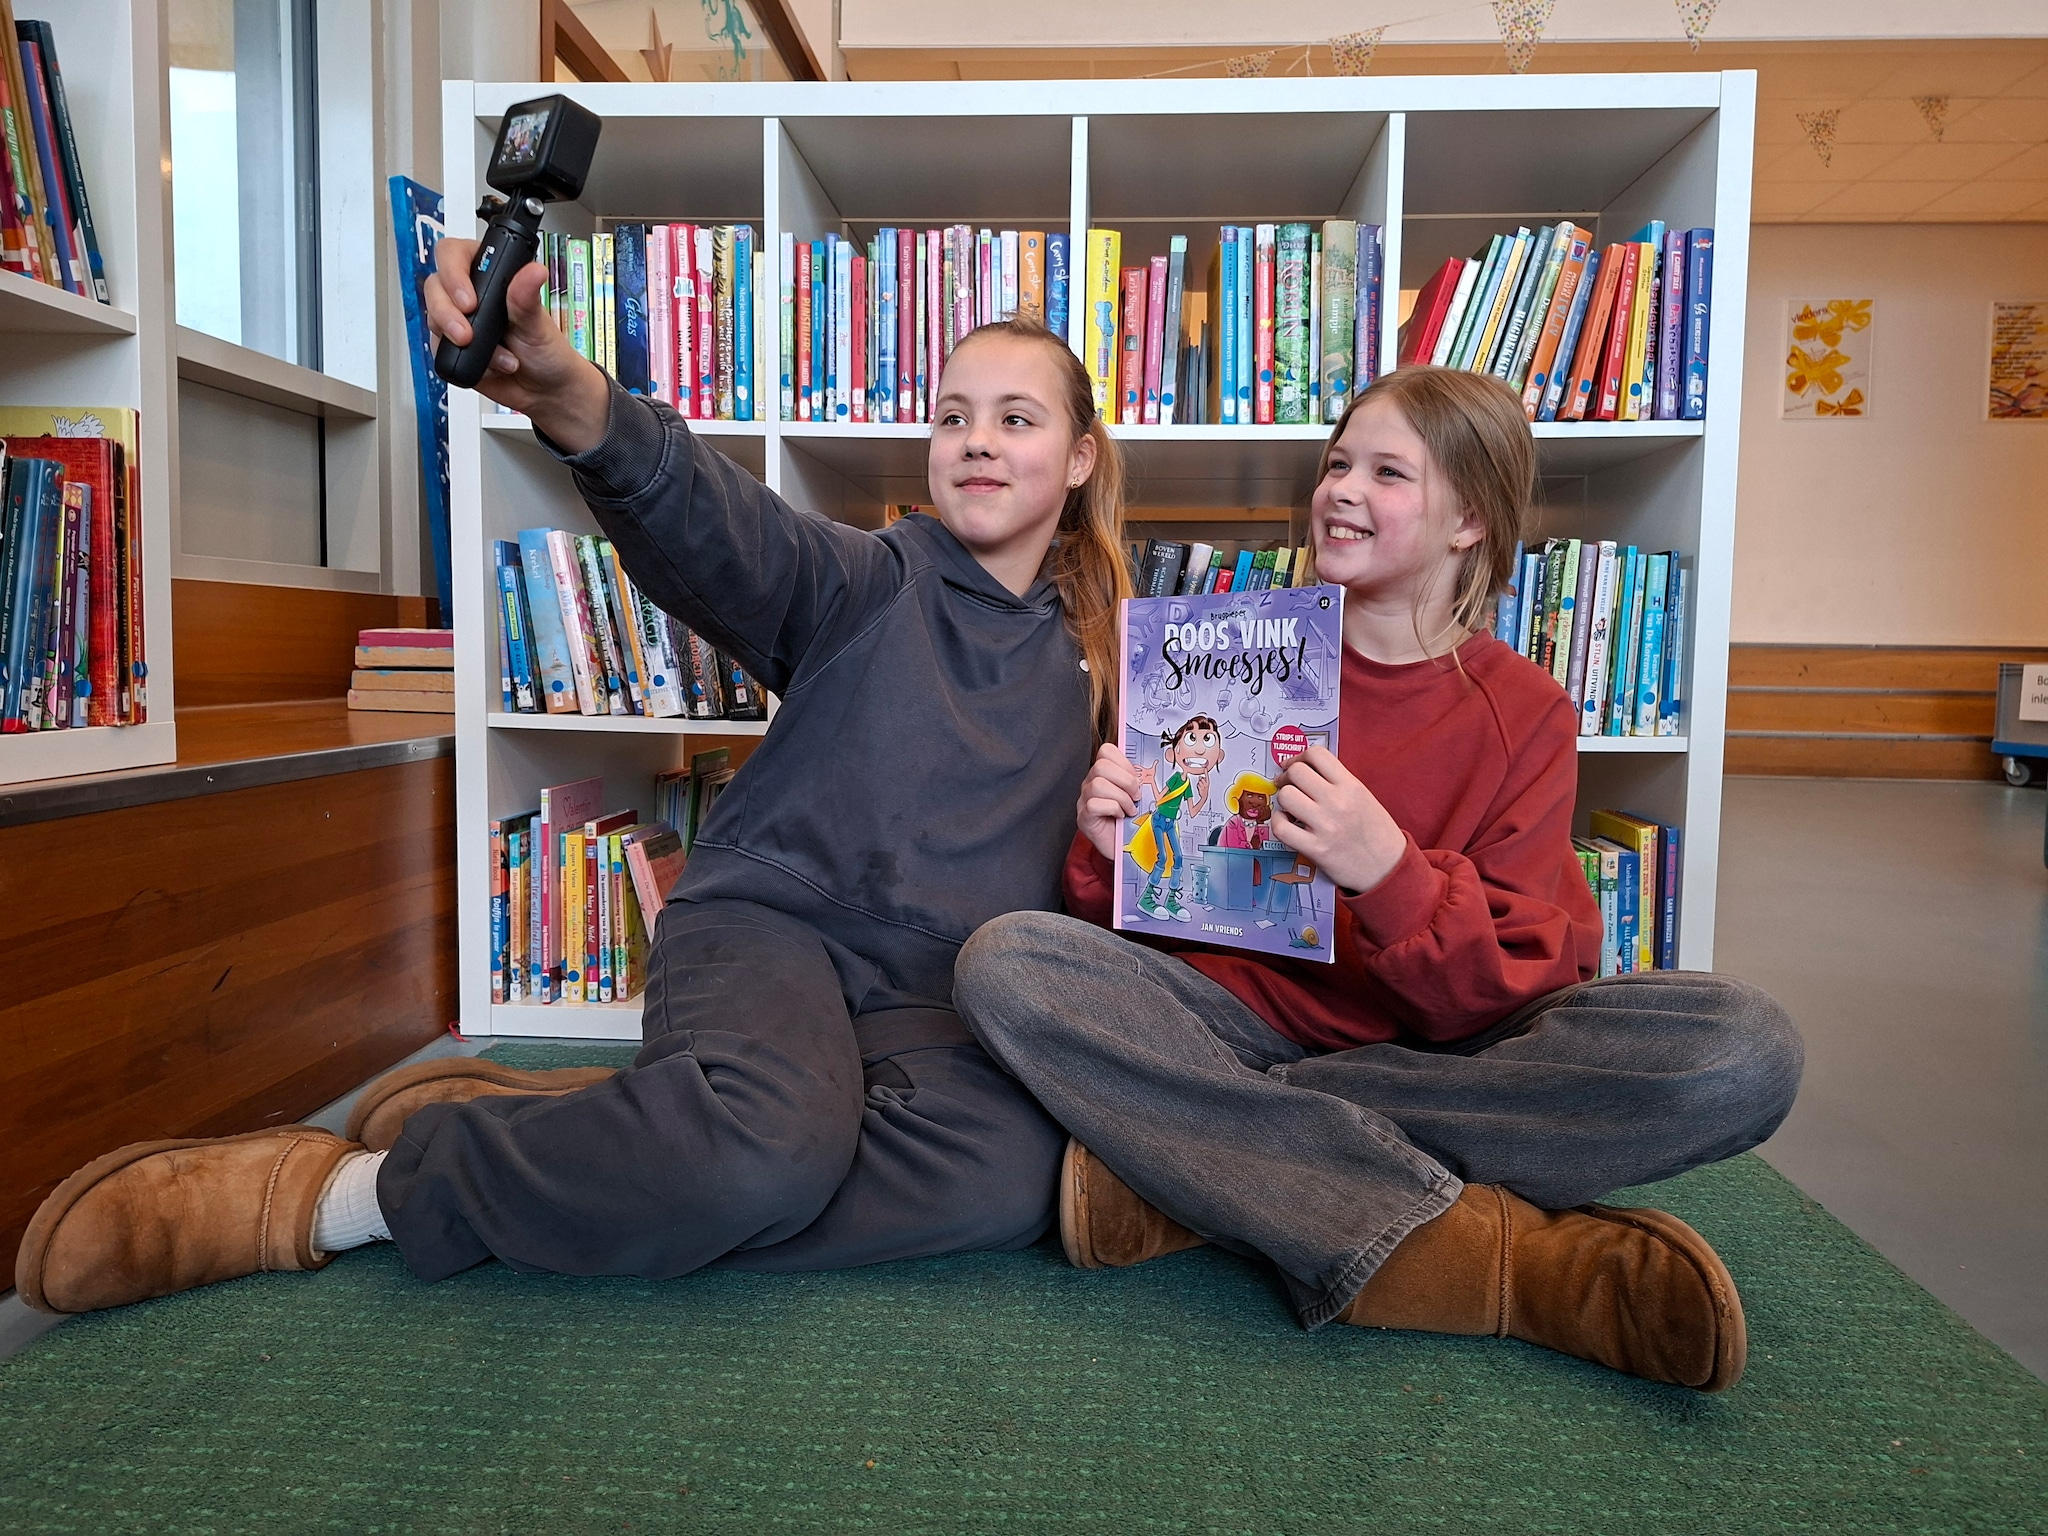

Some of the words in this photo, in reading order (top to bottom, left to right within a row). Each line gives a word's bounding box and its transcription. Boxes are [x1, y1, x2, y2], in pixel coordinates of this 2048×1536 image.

[5, 110, 19, 153] Dolfijn
[901, 246, 910, 261] Carry
[1024, 252, 1036, 273] Carry
[1050, 241, 1065, 267] Carry
[801, 254, 810, 274] CARRY
[1672, 256, 1681, 276] CARRY
[801, 275, 809, 289] SLEE
[1672, 276, 1681, 290] SLEE
[1226, 290, 1234, 305] Met
[1279, 260, 1303, 338] ROBIJN
[1544, 297, 1550, 307] De
[623, 297, 642, 337] Gaas
[1226, 305, 1233, 314] je
[1329, 298, 1341, 334] Lampje
[725, 308, 733, 351] Ministerie
[800, 297, 810, 353] PIJNSTILLERS
[1226, 314, 1234, 337] hoofd
[1523, 308, 1545, 363] zwijnenbende
[1226, 337, 1234, 357] boven
[801, 360, 809, 386] FILMEDIT
[1155, 545, 1175, 553] BOVEN
[529, 549, 542, 579] Krekel
[1538, 562, 1546, 582] Jacques
[1552, 549, 1562, 578] JACQUES
[1567, 549, 1577, 576] Jacques
[1550, 581, 1560, 603] VRIENS
[1566, 578, 1574, 597] Vriens
[1211, 609, 1246, 621] Brugpieper
[1533, 615, 1541, 634] Steffie
[1655, 613, 1662, 625] De
[1165, 621, 1230, 652] ROOS
[1240, 618, 1299, 648] VINK
[1532, 636, 1539, 644] en
[1646, 629, 1653, 642] De
[1531, 645, 1539, 653] de
[1576, 638, 1584, 656] BETON
[1591, 643, 1601, 667] STIJN,
[1162, 637, 1306, 695] Smoesjes!
[1642, 642, 1653, 685] Korenwolf
[1591, 669, 1600, 700] UITVIND
[1273, 742, 1306, 752] TIJDSCHRIFT
[1275, 733, 1294, 742] STRIPS
[1277, 753, 1296, 763] TiN
[569, 843, 577, 867] Jacques
[587, 885, 594, 893] En
[491, 897, 501, 922] Dolfijn
[587, 894, 595, 907] hier
[587, 924, 595, 943] Niels!
[1201, 922, 1213, 932] JAN
[1214, 924, 1243, 937] VRIENDS
